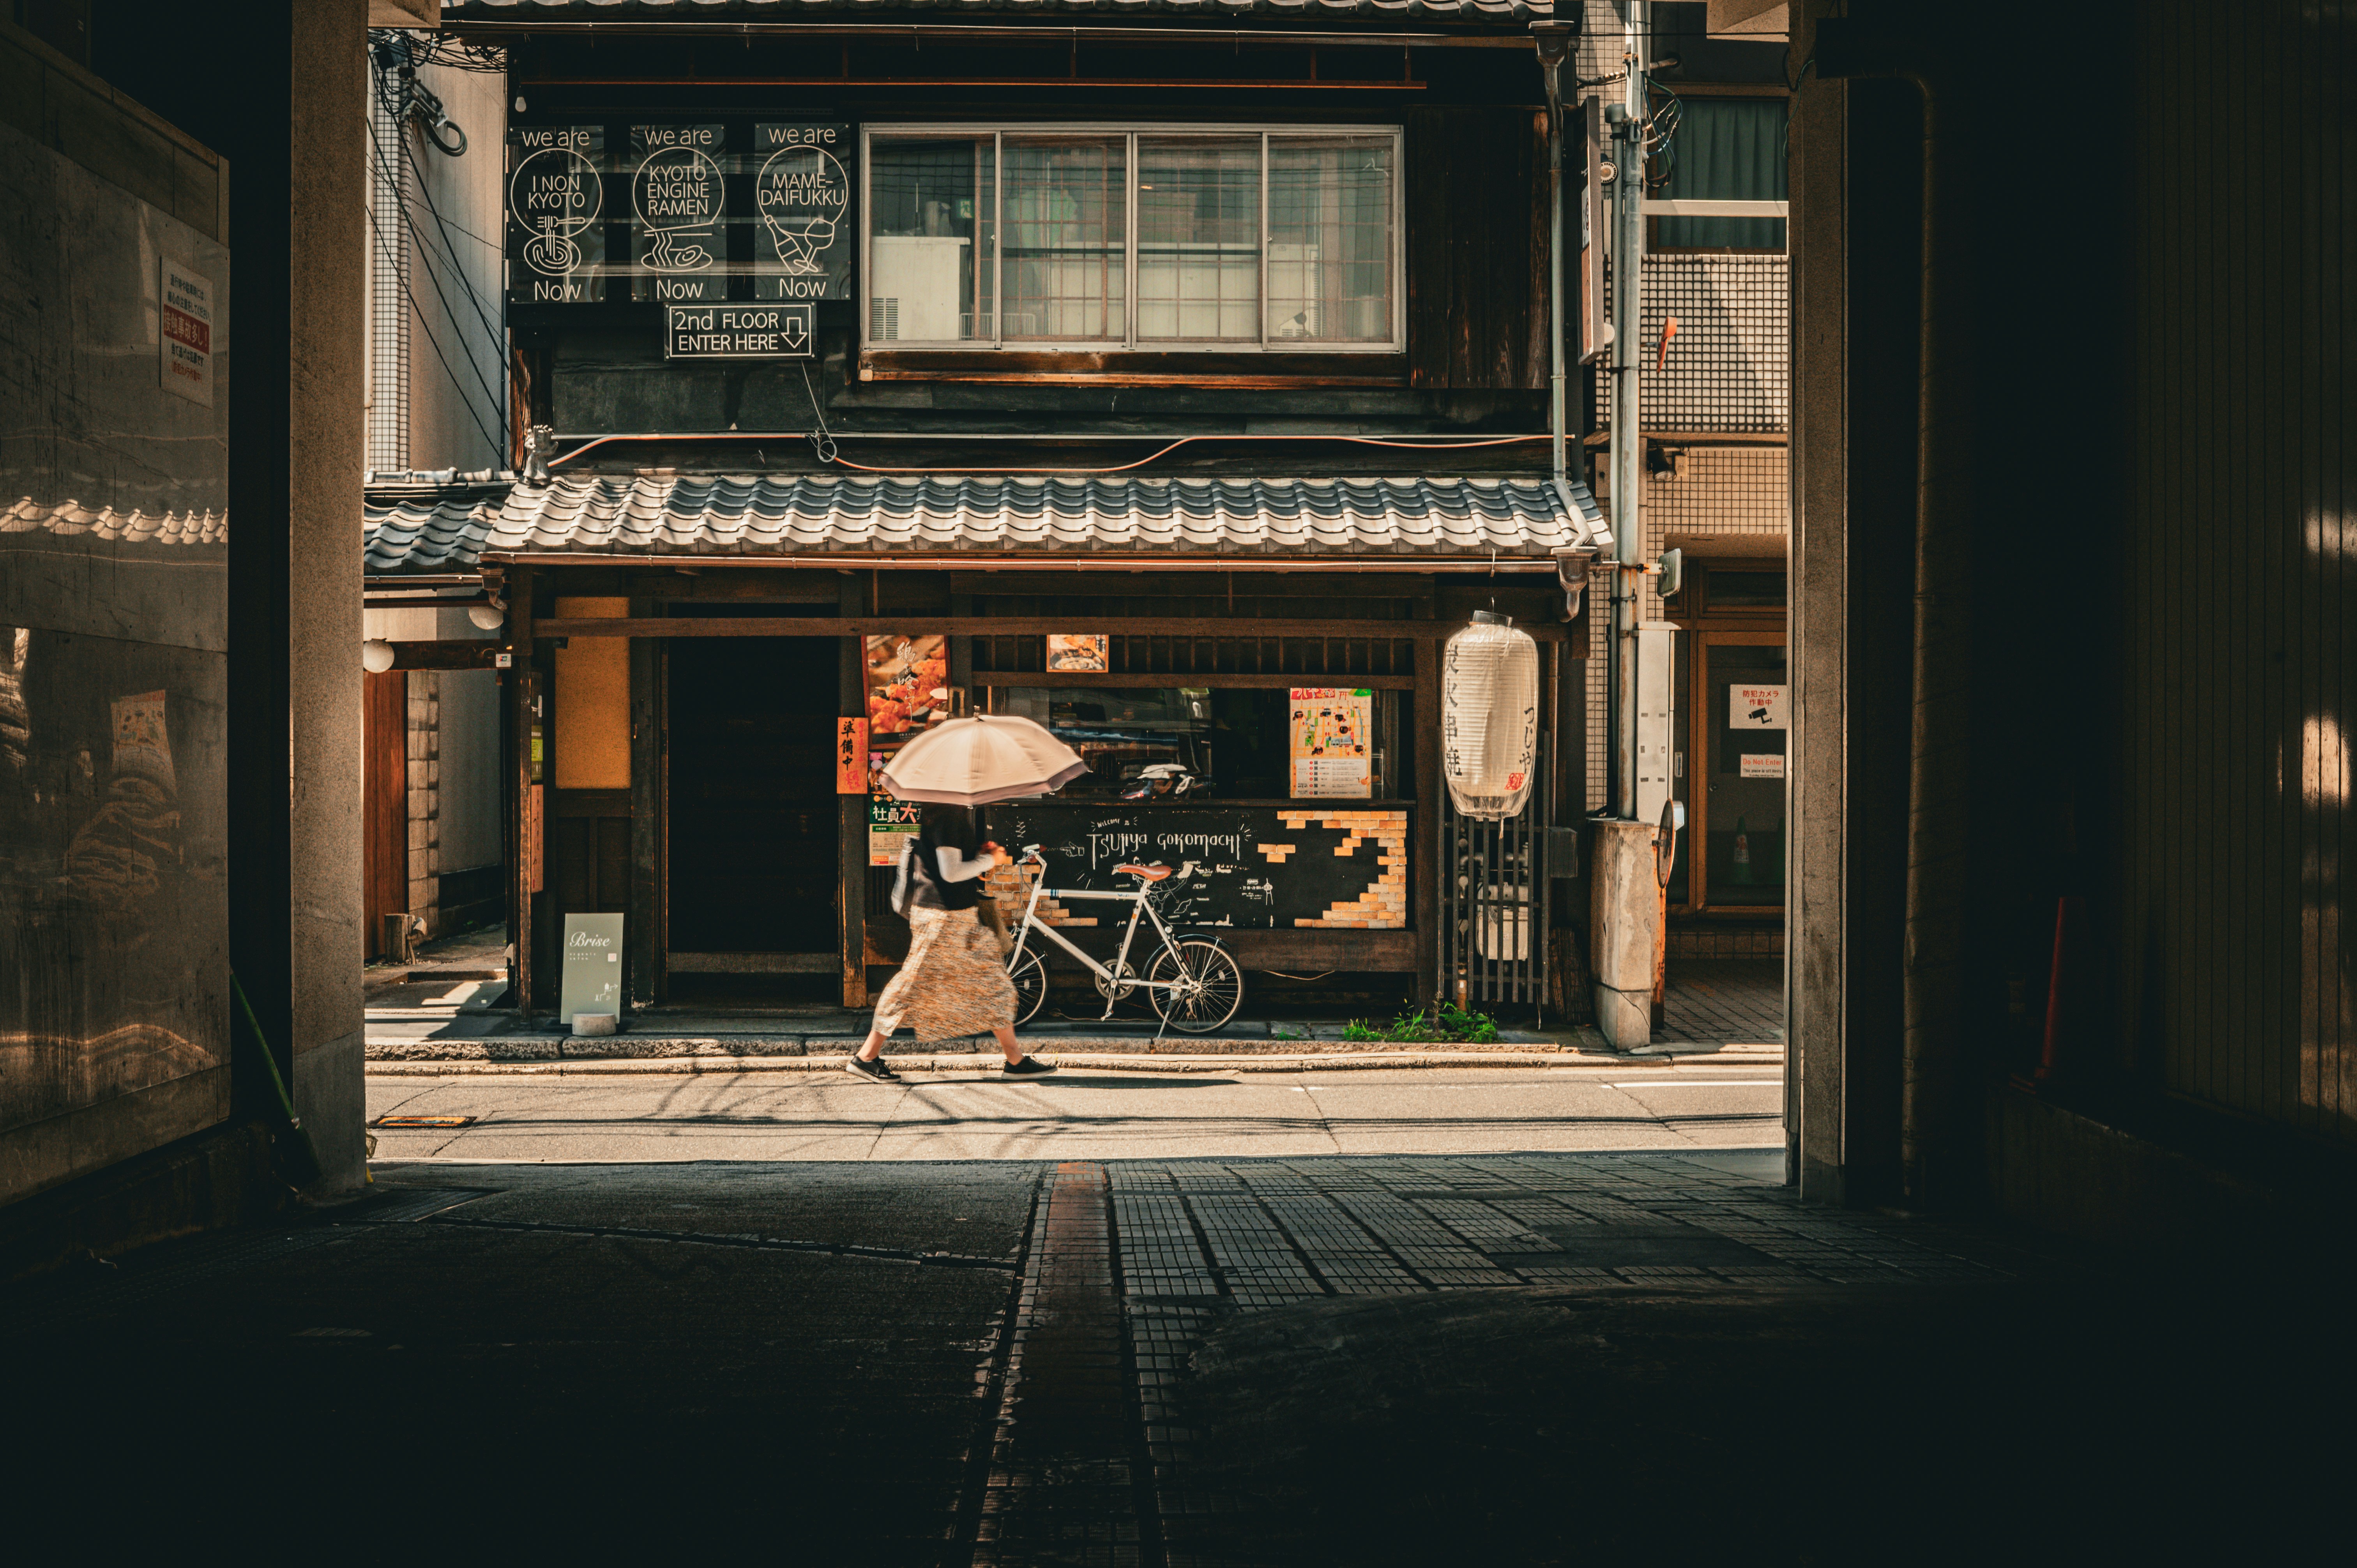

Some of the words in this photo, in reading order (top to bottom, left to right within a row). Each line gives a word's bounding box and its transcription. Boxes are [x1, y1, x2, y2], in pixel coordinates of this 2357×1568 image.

[522, 131, 553, 146] we
[557, 131, 590, 146] are
[645, 130, 675, 145] we
[680, 129, 712, 145] are
[769, 129, 800, 143] we
[804, 128, 836, 143] are
[649, 165, 706, 182] KYOTO
[772, 173, 834, 189] MAME-
[532, 176, 535, 191] I
[542, 175, 580, 191] NON
[647, 183, 710, 199] ENGINE
[528, 192, 585, 209] KYOTO
[761, 189, 845, 206] DAIFUKKU
[648, 200, 709, 215] RAMEN
[535, 281, 581, 301] Now
[657, 279, 703, 299] Now
[779, 278, 826, 297] Now
[675, 310, 713, 330] 2nd
[723, 313, 779, 329] FLOOR
[678, 334, 730, 351] ENTER
[735, 334, 778, 350] HERE
[840, 721, 855, 771] 準備中
[1519, 706, 1535, 775] つじや
[569, 931, 611, 947] Brise
